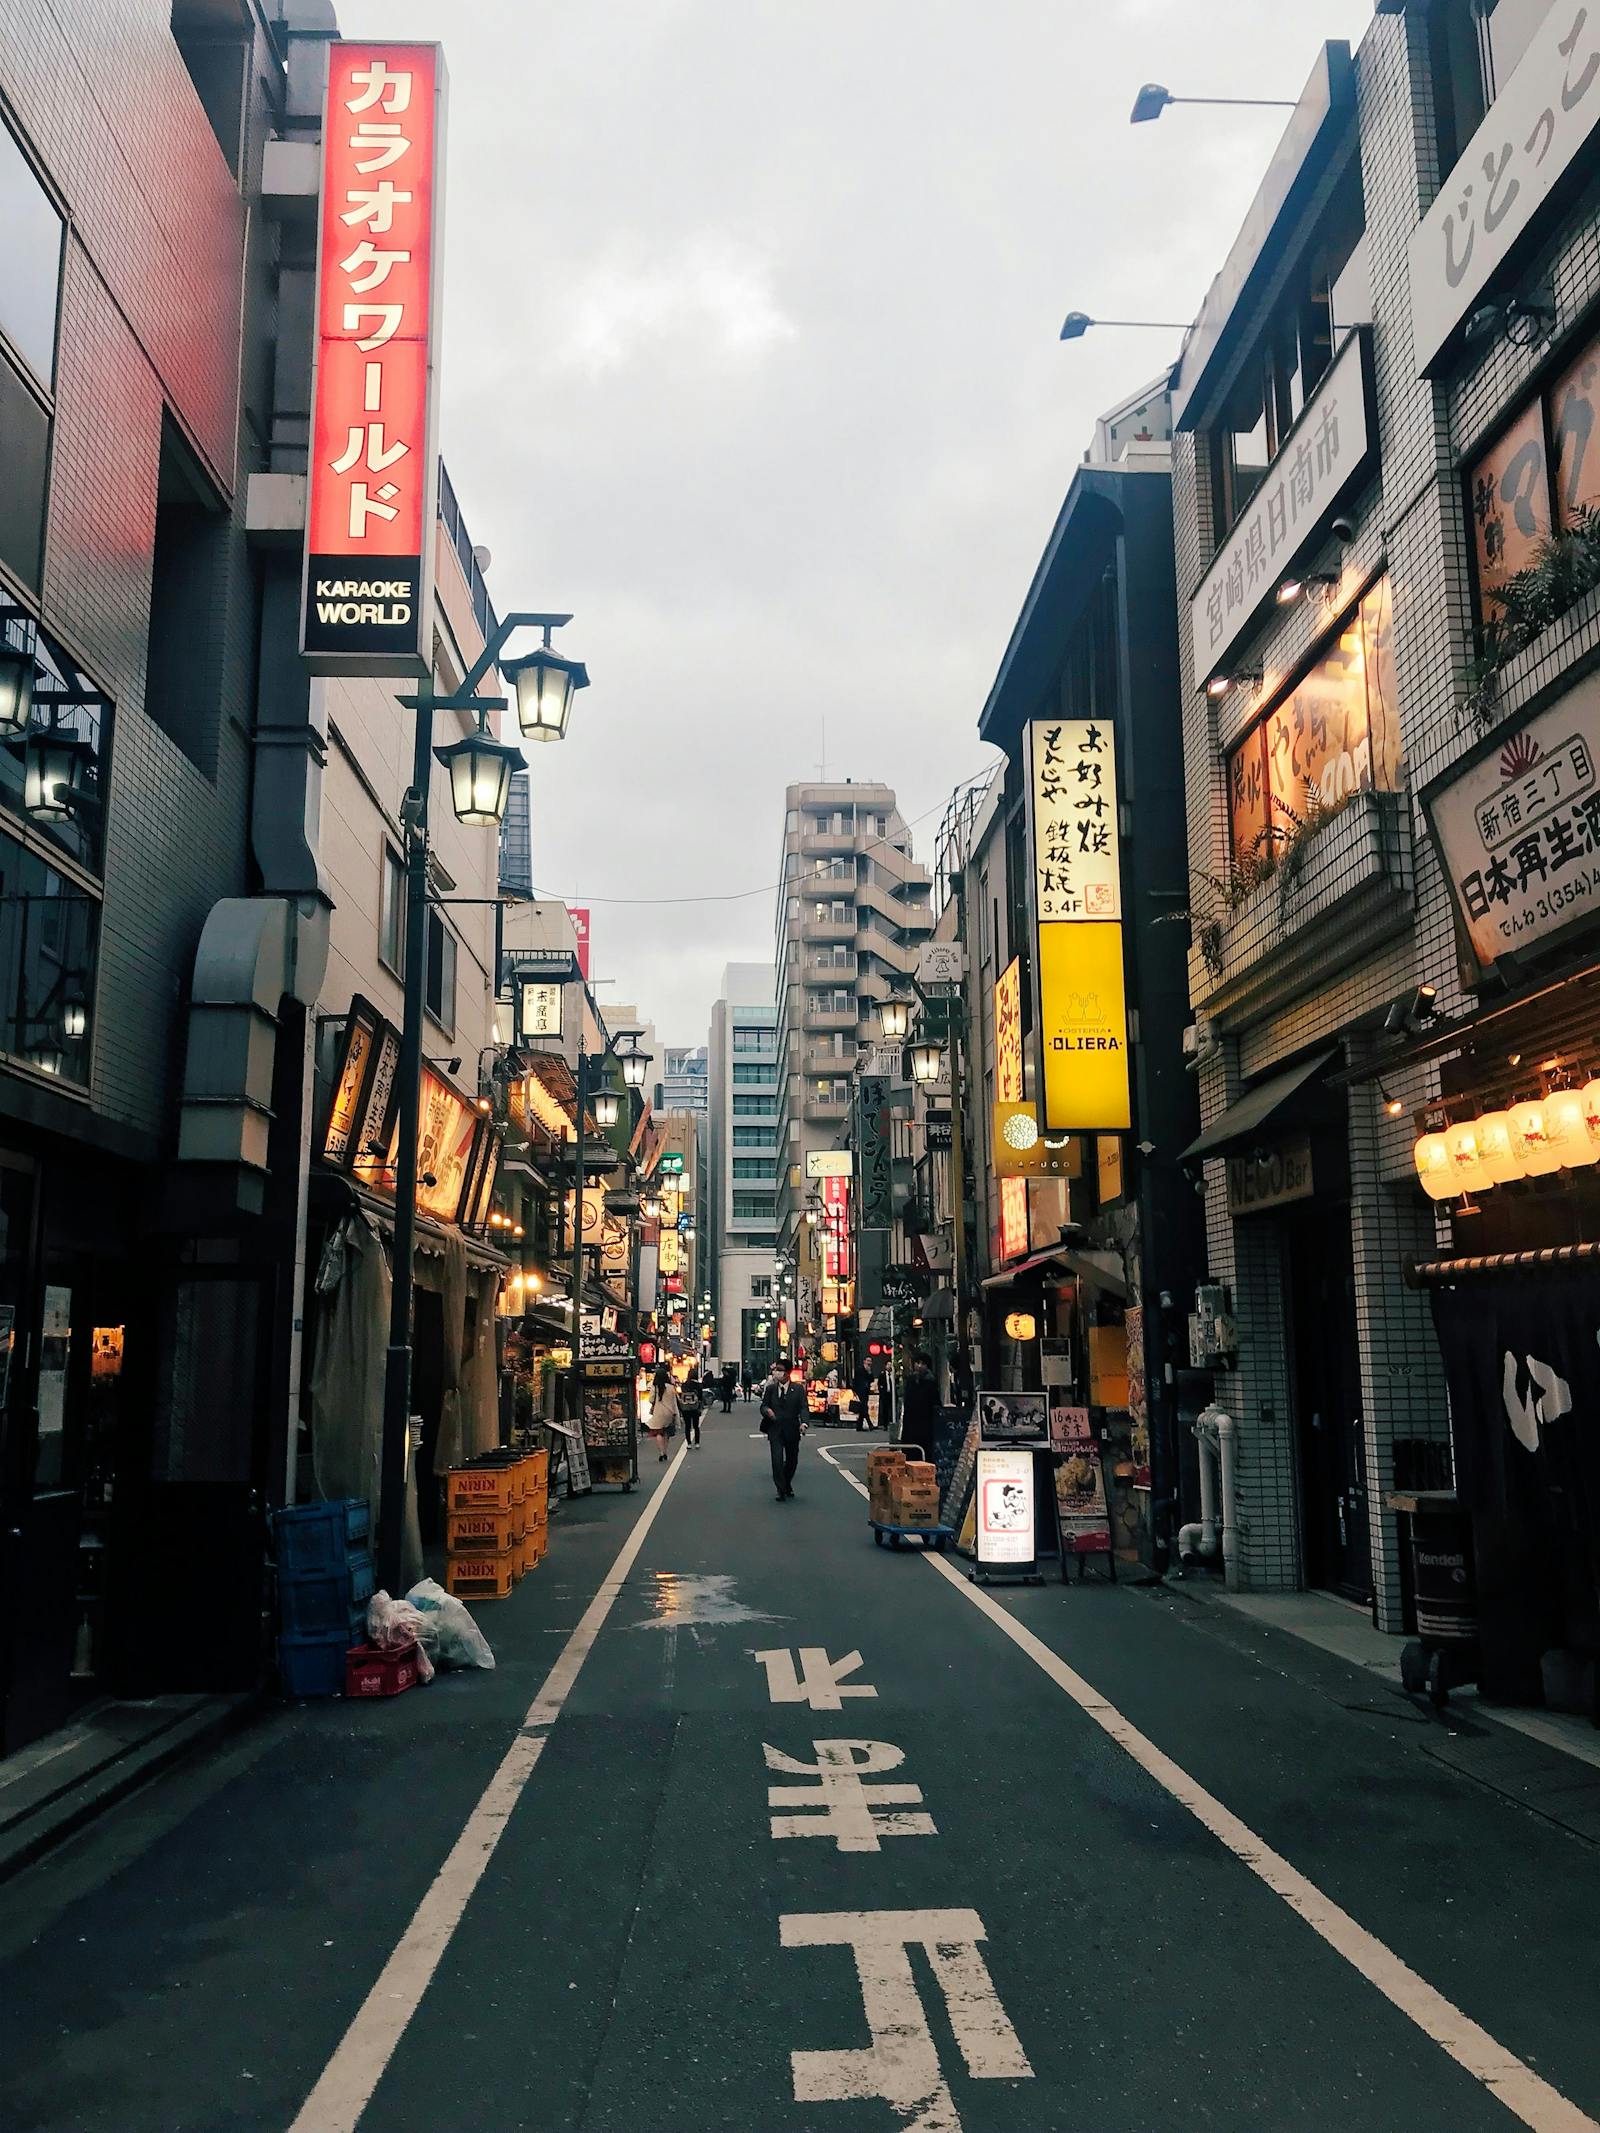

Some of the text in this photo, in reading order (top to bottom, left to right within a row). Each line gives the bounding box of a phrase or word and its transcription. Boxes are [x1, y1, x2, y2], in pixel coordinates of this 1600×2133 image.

[329, 60, 413, 540] カラオケワールド
[1206, 400, 1340, 651] 宮崎県日南市
[316, 580, 411, 599] KARAOKE
[316, 602, 411, 626] WORLD
[1068, 723, 1112, 857] お好み焼
[1480, 744, 1590, 842] 新宿三丁目
[1038, 725, 1075, 896] もんじゃ 鉄板焼
[1499, 908, 1535, 938] でんわ
[458, 1479, 496, 1492] KIRIN
[457, 1521, 495, 1533] KIRIN
[456, 1564, 495, 1577] KIRIN
[1418, 1552, 1464, 1567] Kendall
